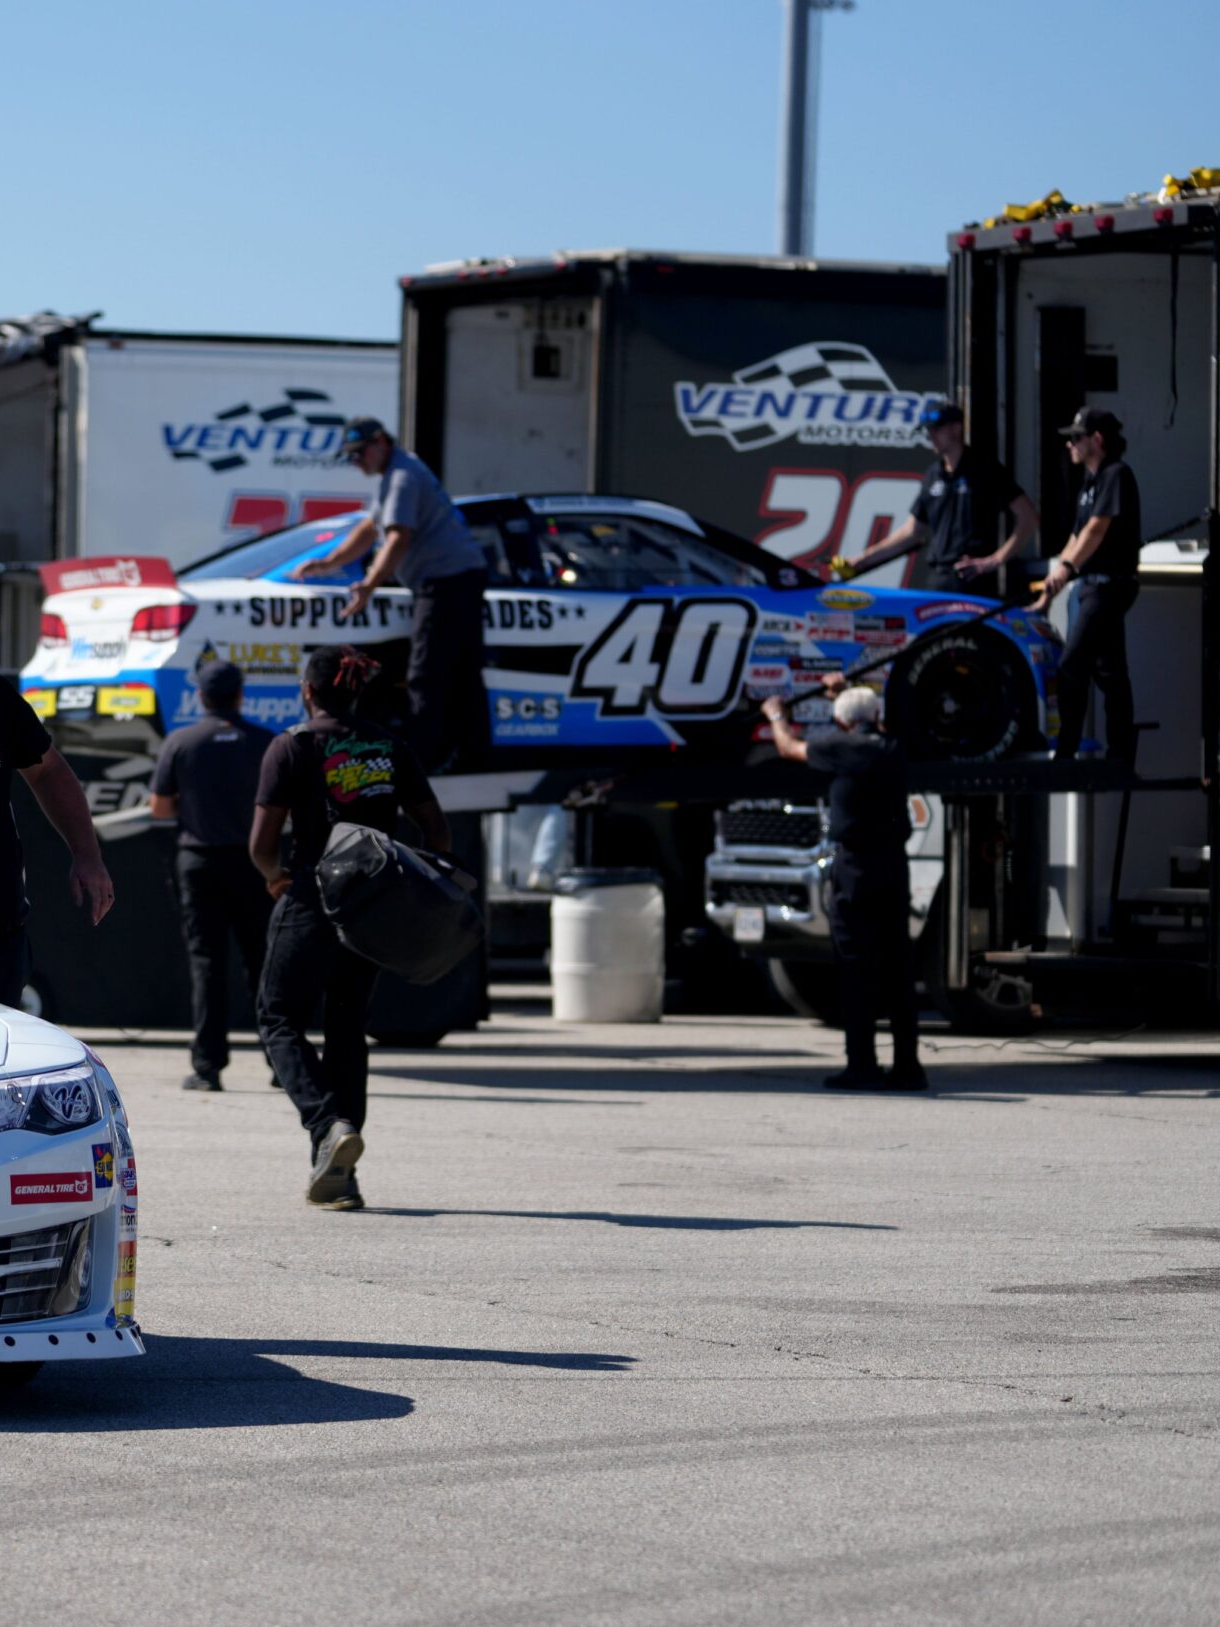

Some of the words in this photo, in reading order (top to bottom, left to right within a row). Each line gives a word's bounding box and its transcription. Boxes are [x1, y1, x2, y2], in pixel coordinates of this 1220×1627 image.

[678, 393, 921, 423] VENTUR
[162, 423, 344, 453] VENTU
[483, 599, 554, 630] ADES
[569, 595, 759, 718] 40
[14, 1183, 55, 1196] GENERAL
[55, 1182, 75, 1193] TIRE
